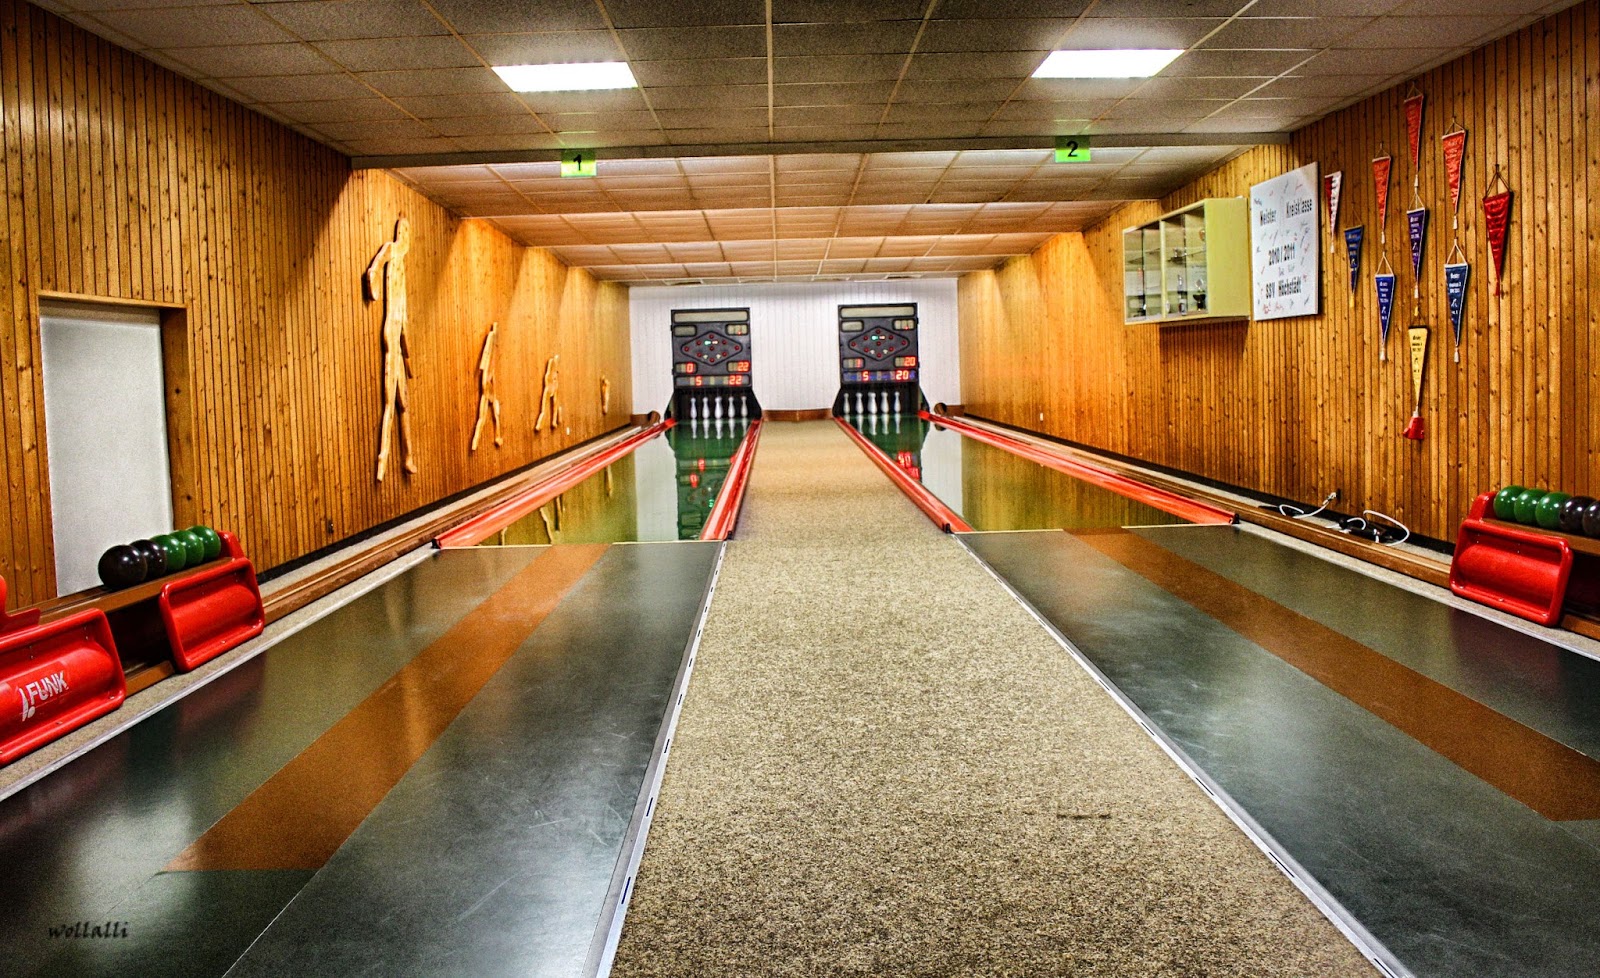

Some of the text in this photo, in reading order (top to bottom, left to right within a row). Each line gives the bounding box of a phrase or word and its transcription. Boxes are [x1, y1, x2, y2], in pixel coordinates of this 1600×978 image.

[1067, 141, 1078, 157] 2
[573, 154, 582, 171] 1
[737, 361, 750, 372] 22
[904, 356, 916, 367] 20
[686, 362, 695, 374] 0
[695, 375, 703, 386] 5
[729, 374, 743, 386] 22
[862, 370, 870, 381] 5
[895, 369, 910, 381] 20
[25, 671, 69, 706] FUNK
